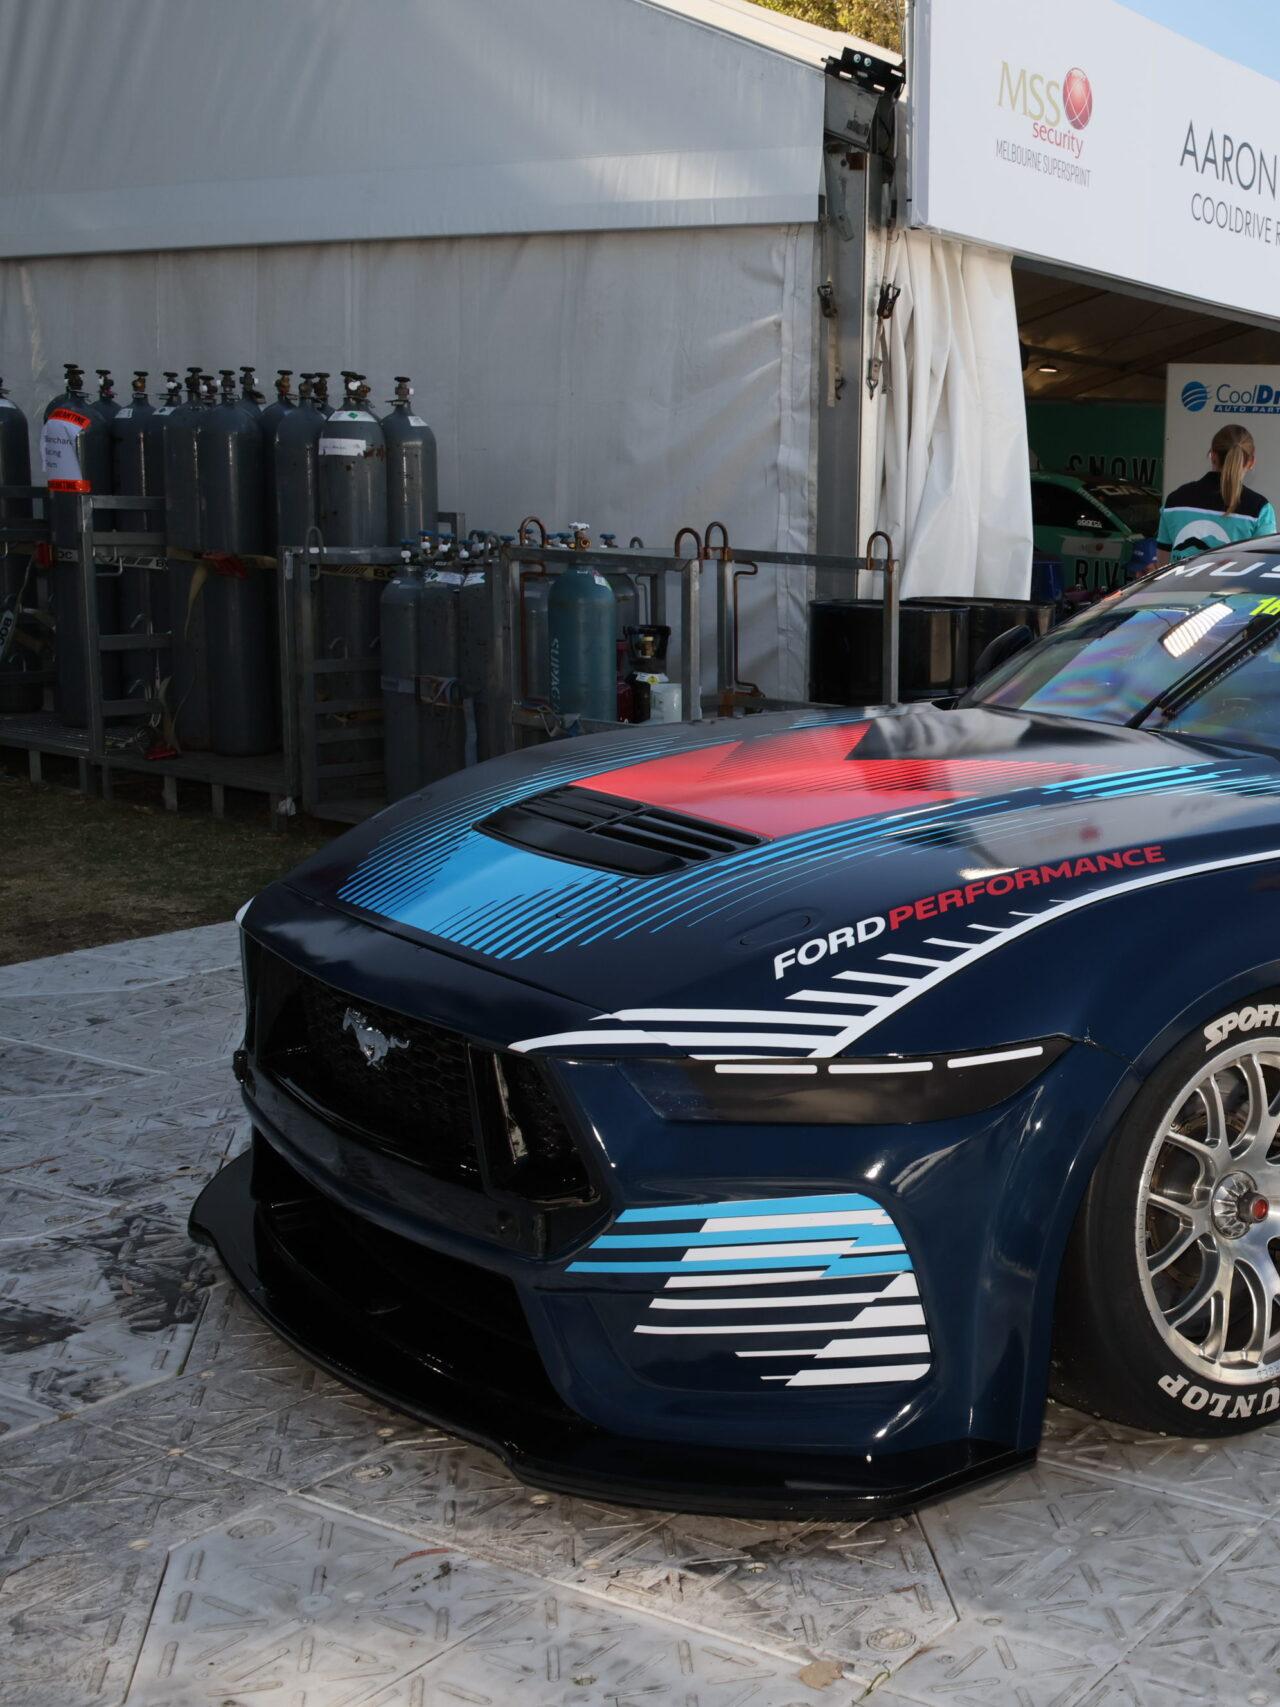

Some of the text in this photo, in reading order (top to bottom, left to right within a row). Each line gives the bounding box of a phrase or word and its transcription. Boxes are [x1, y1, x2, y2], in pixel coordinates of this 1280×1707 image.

[998, 60, 1061, 127] MSS
[995, 139, 1091, 187] MELBOURNE SUPERSPRINT
[1032, 121, 1084, 159] security
[1180, 119, 1277, 200] AARON
[1191, 193, 1272, 243] COOLDRIVE
[773, 845, 1165, 980] FORD PERFORMANCE
